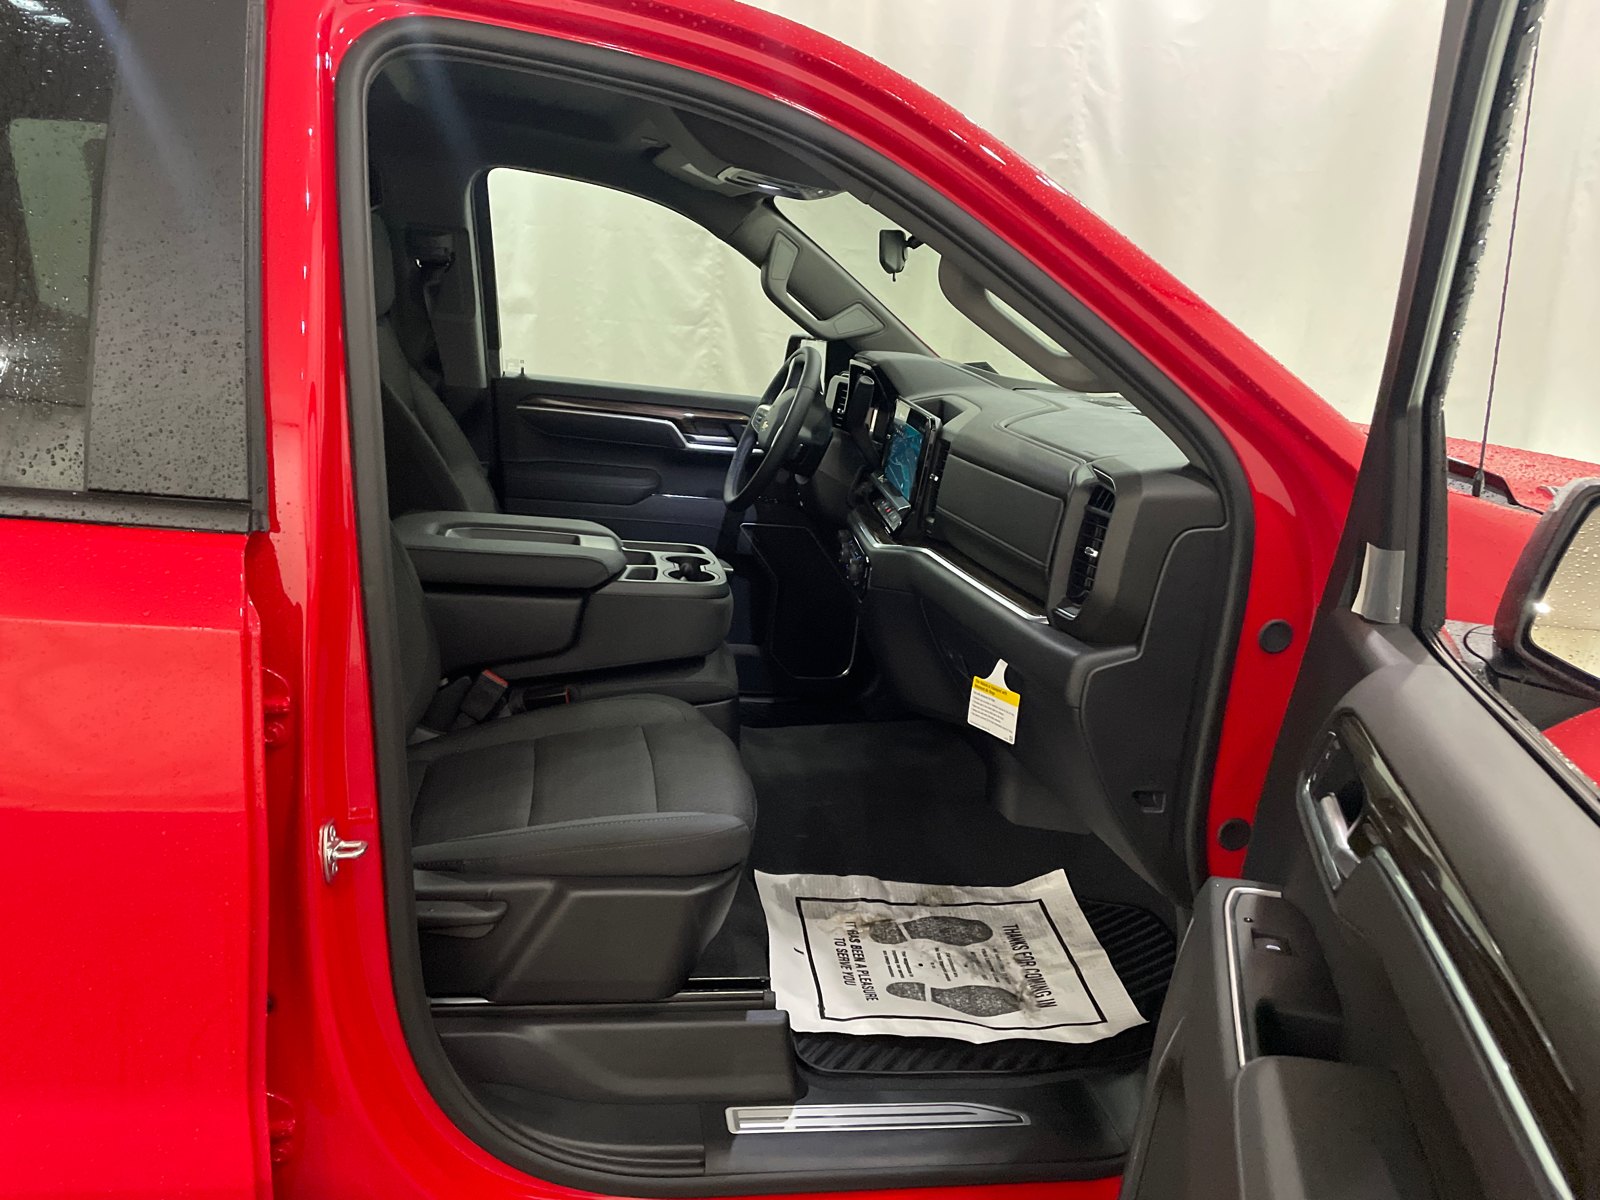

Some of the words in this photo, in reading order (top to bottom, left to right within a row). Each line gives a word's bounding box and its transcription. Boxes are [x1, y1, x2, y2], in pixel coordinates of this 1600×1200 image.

[845, 921, 857, 929] IT
[834, 937, 847, 947] TO
[847, 929, 861, 943] HAS
[1002, 924, 1029, 951] THANKS
[836, 948, 852, 970] SERVE
[850, 945, 866, 962] BEEN
[1014, 951, 1036, 967] FOR
[842, 971, 856, 986] YOU
[857, 969, 879, 1001] PLEASURE
[1024, 968, 1052, 998] COMING
[1035, 998, 1057, 1008] IN
